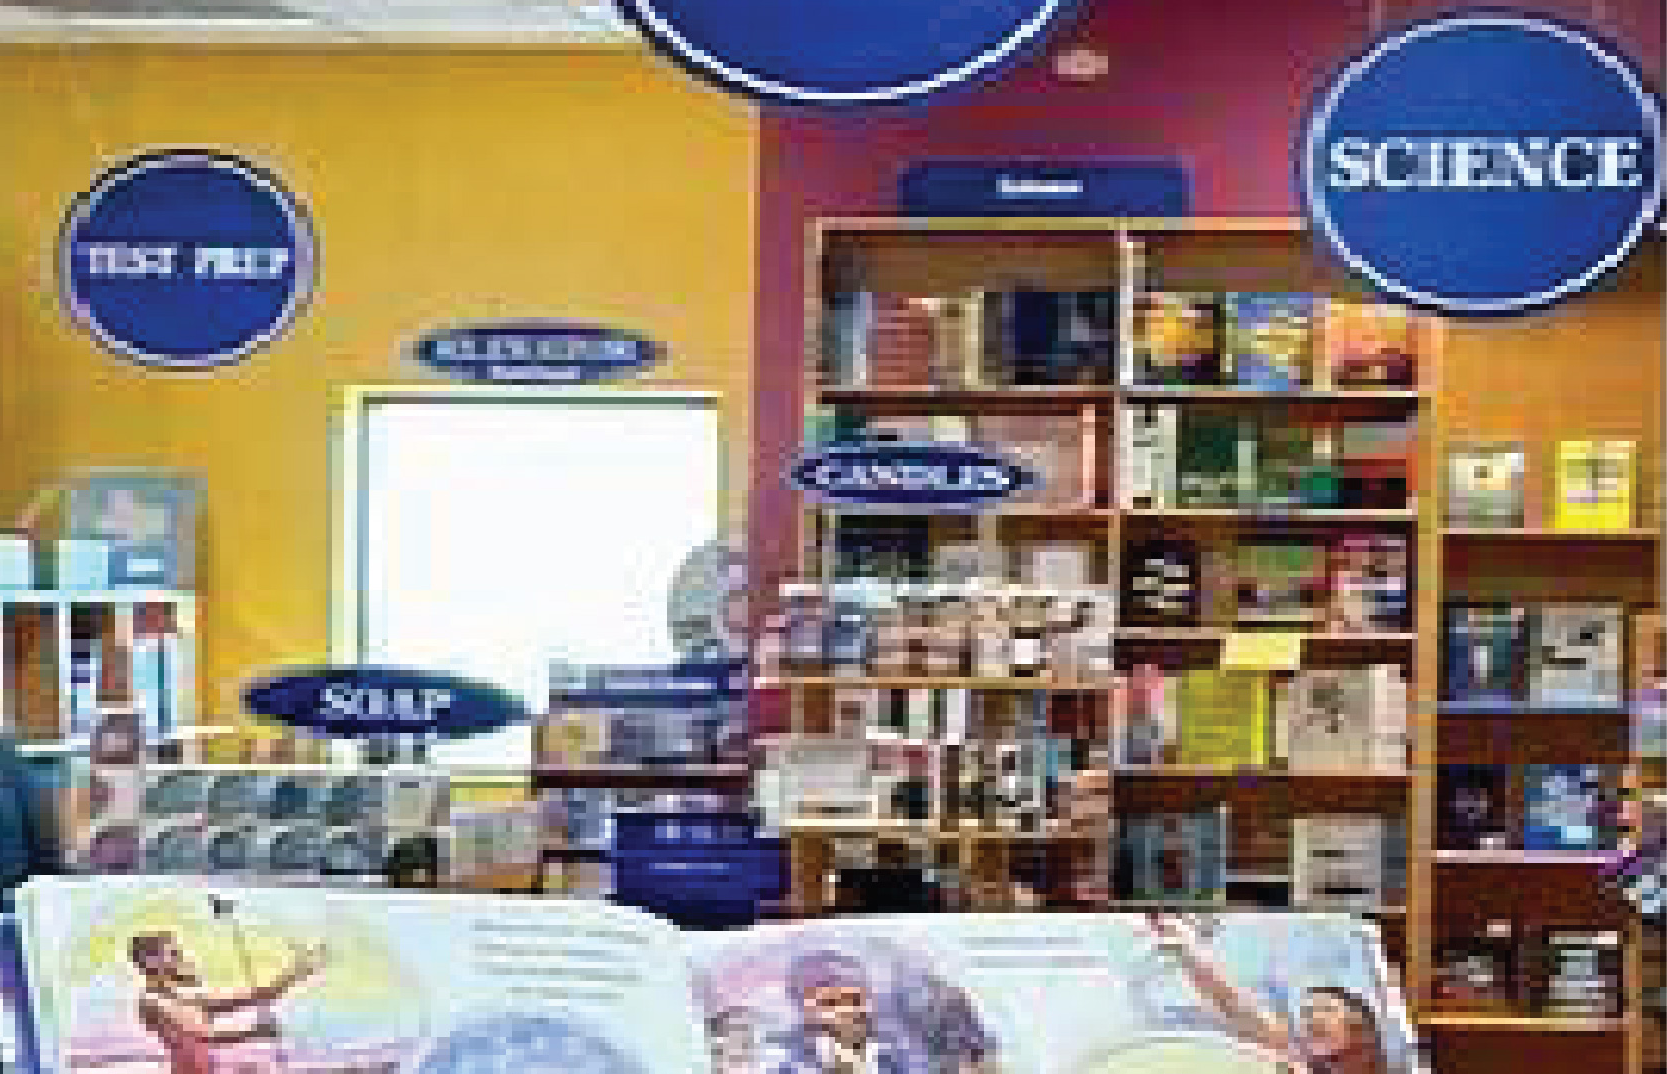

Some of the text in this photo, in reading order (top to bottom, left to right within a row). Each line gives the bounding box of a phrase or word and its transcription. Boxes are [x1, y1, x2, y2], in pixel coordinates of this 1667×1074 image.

[1329, 137, 1643, 187] SCIENCE
[80, 242, 178, 278] TEST
[813, 457, 1012, 493] CANDLES
[319, 684, 454, 722] SOAP
